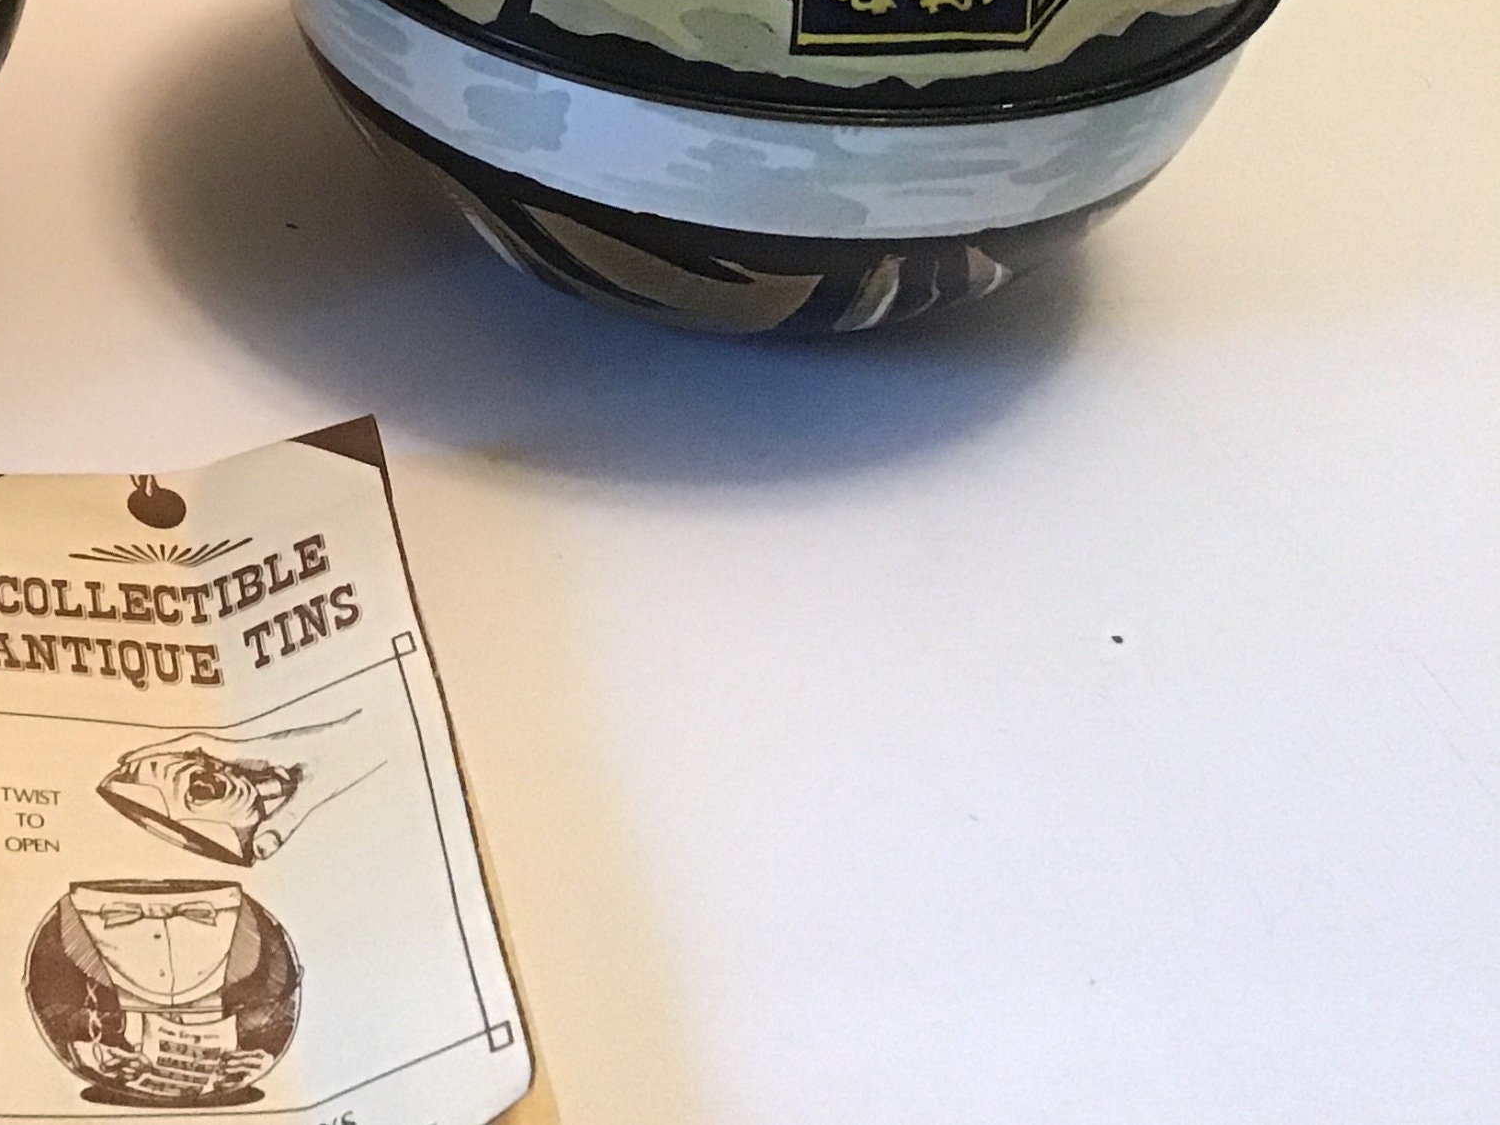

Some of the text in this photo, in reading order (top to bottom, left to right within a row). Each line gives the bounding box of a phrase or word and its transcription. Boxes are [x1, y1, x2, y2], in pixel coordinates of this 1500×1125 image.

[243, 583, 361, 670] TINS
[0, 787, 61, 806] TWIST
[15, 812, 45, 829] TO
[5, 836, 60, 853] OPEN
